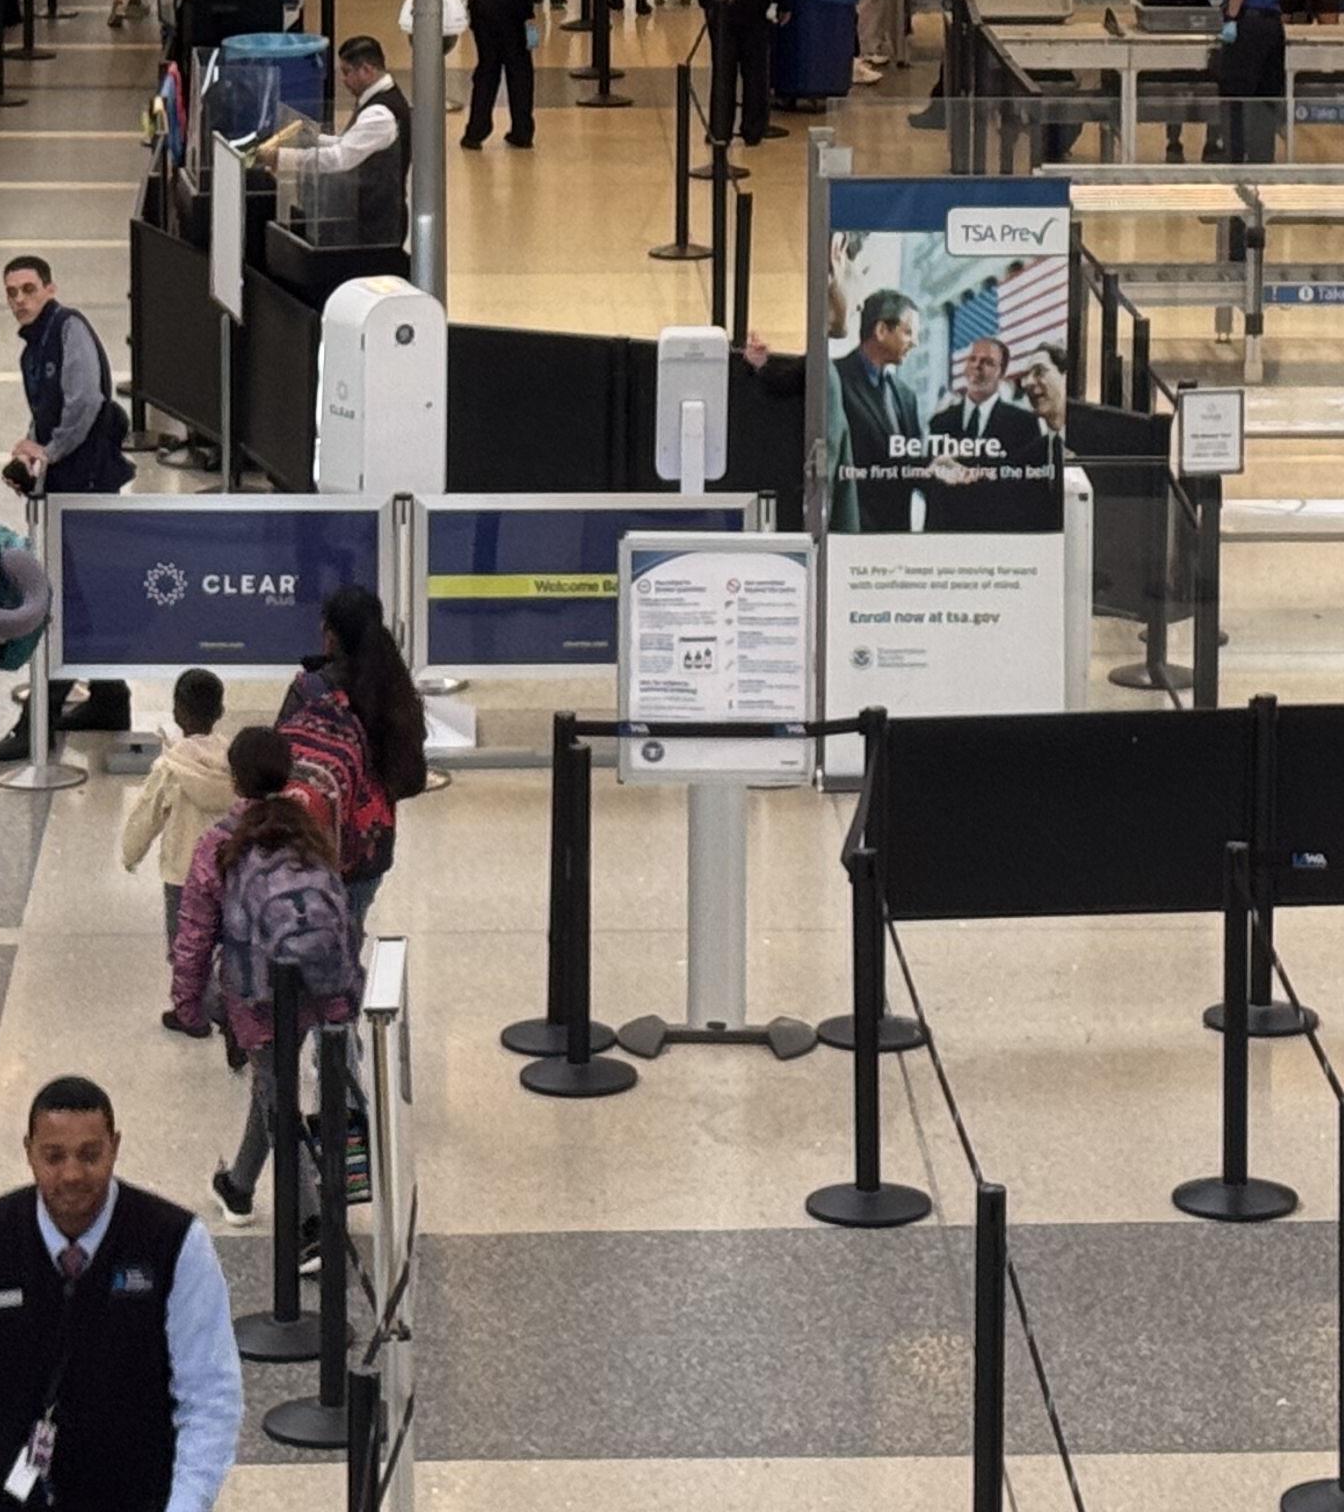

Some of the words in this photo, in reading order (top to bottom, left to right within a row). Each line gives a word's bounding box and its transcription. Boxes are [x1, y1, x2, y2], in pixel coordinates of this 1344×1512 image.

[961, 224, 997, 242] TSA
[1000, 224, 1030, 242] Pre
[889, 435, 921, 457] Be
[927, 433, 1007, 458] There.
[870, 465, 898, 479] first
[901, 465, 932, 479] time
[968, 466, 998, 481] ring
[1000, 465, 1022, 479] the
[202, 574, 296, 595] CLEAR
[534, 579, 599, 593] Welcome
[849, 611, 891, 624] Enroll
[894, 612, 926, 624] now
[928, 611, 943, 623] at
[946, 611, 1001, 626] tsa.gov
